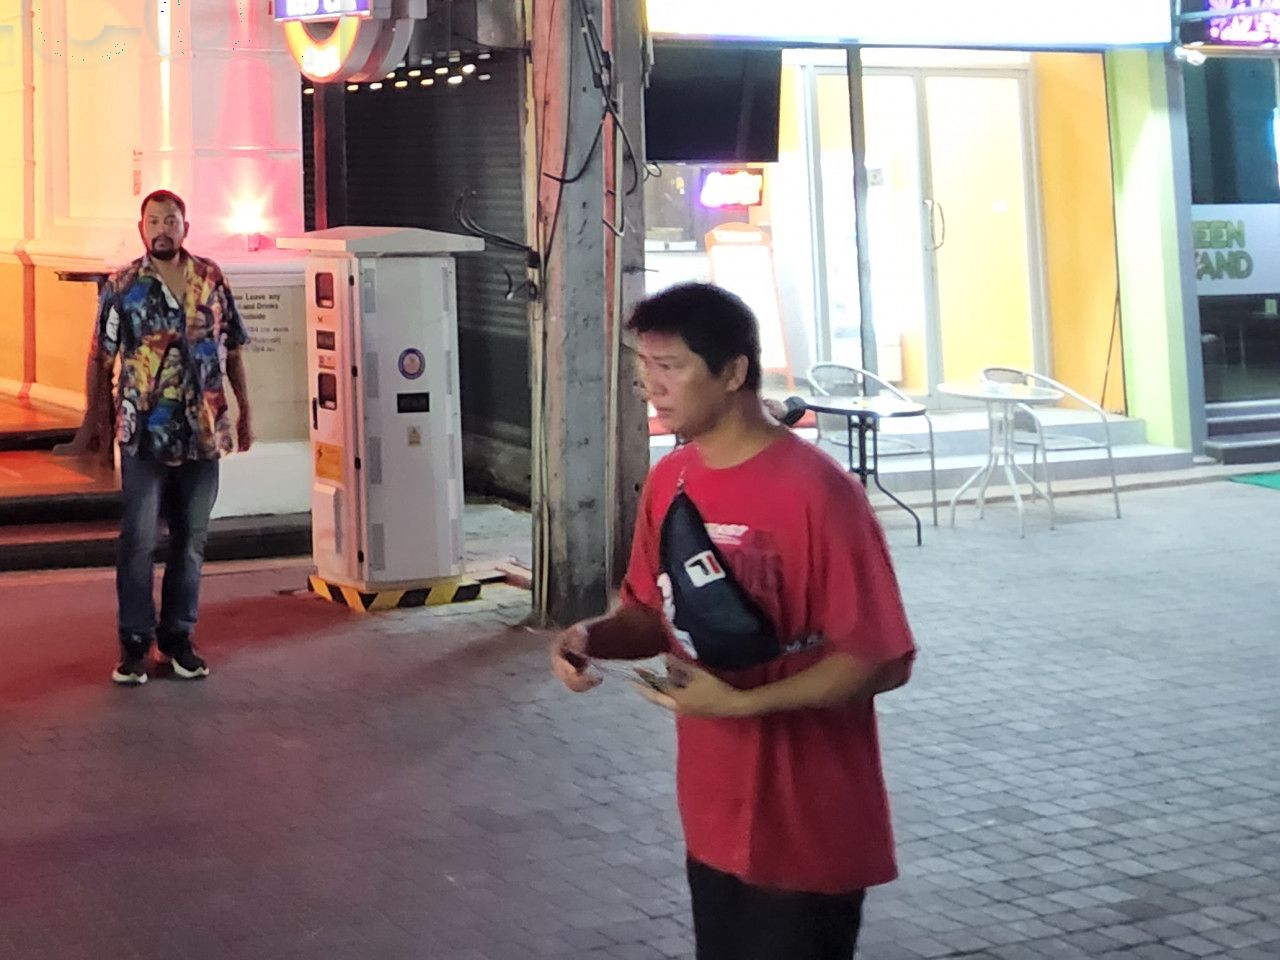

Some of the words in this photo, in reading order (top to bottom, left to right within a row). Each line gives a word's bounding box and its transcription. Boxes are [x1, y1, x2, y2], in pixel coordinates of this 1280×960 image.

[1195, 249, 1253, 280] AND
[245, 293, 266, 301] Leave
[269, 294, 281, 302] any
